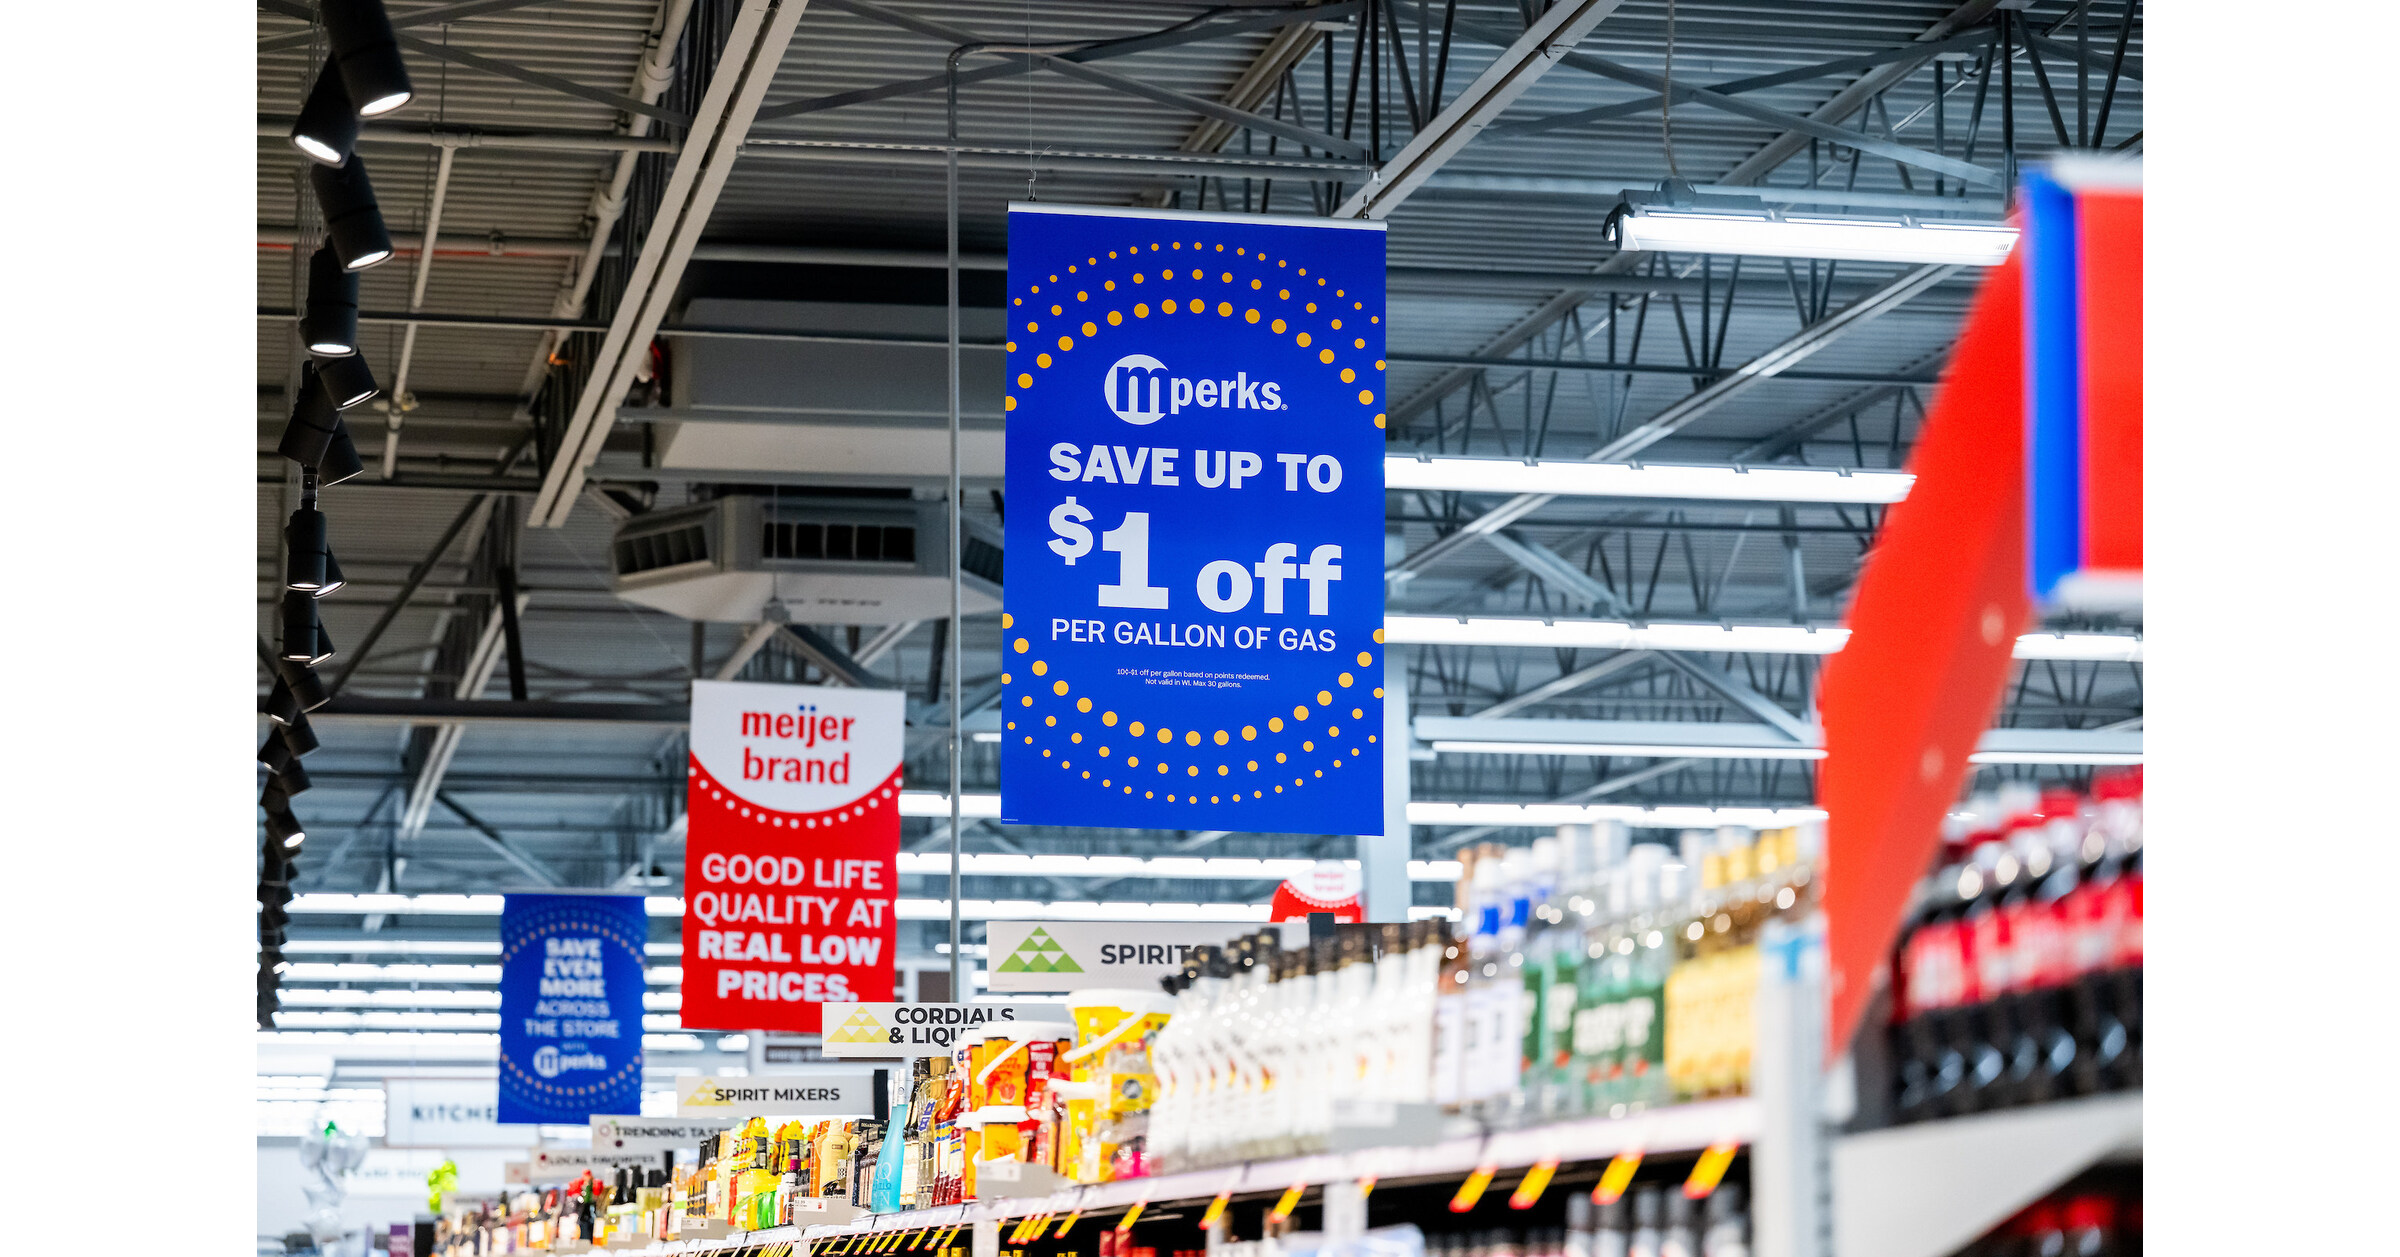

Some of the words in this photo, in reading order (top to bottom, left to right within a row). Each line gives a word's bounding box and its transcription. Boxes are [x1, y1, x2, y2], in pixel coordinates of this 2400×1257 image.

[1048, 442, 1180, 487] SAVE
[1194, 449, 1263, 489] UP
[1276, 453, 1343, 493] TO
[1047, 496, 1169, 610] $1
[1196, 542, 1342, 616] off
[1051, 617, 1106, 643] PER
[1113, 620, 1226, 649] GALLON
[1234, 626, 1271, 650] OF
[1278, 628, 1337, 652] GAS
[1150, 670, 1162, 678] per
[1162, 670, 1182, 678] gallon
[1183, 671, 1204, 679] based
[1214, 672, 1235, 680] points
[1235, 673, 1271, 681] redeemed.
[1158, 678, 1173, 686] valid
[1217, 681, 1242, 689] gallons.
[741, 704, 856, 748] meijer
[742, 746, 850, 785] brand
[701, 852, 805, 886] GOOD
[814, 858, 884, 890] LIFE
[694, 891, 840, 927] QUALITY
[846, 897, 889, 928] AT
[545, 937, 602, 957] SAVE
[698, 929, 792, 963] REAL
[800, 934, 882, 967] LOW
[1100, 944, 1194, 965] SPIRIT
[544, 957, 603, 978] EVEN
[539, 977, 606, 998] MORE
[717, 969, 859, 1002] PRICES.
[535, 998, 611, 1019] ACROSS
[894, 1007, 1015, 1025] CORDIALS
[524, 1018, 559, 1038] THE
[562, 1018, 621, 1039] STORE
[888, 1026, 904, 1044] &
[911, 1026, 979, 1047] LIQU
[714, 1088, 770, 1102] SPIRIT
[774, 1088, 840, 1101] MIXERS
[412, 1104, 493, 1122] KITCHE
[615, 1126, 686, 1138] TRENDING
